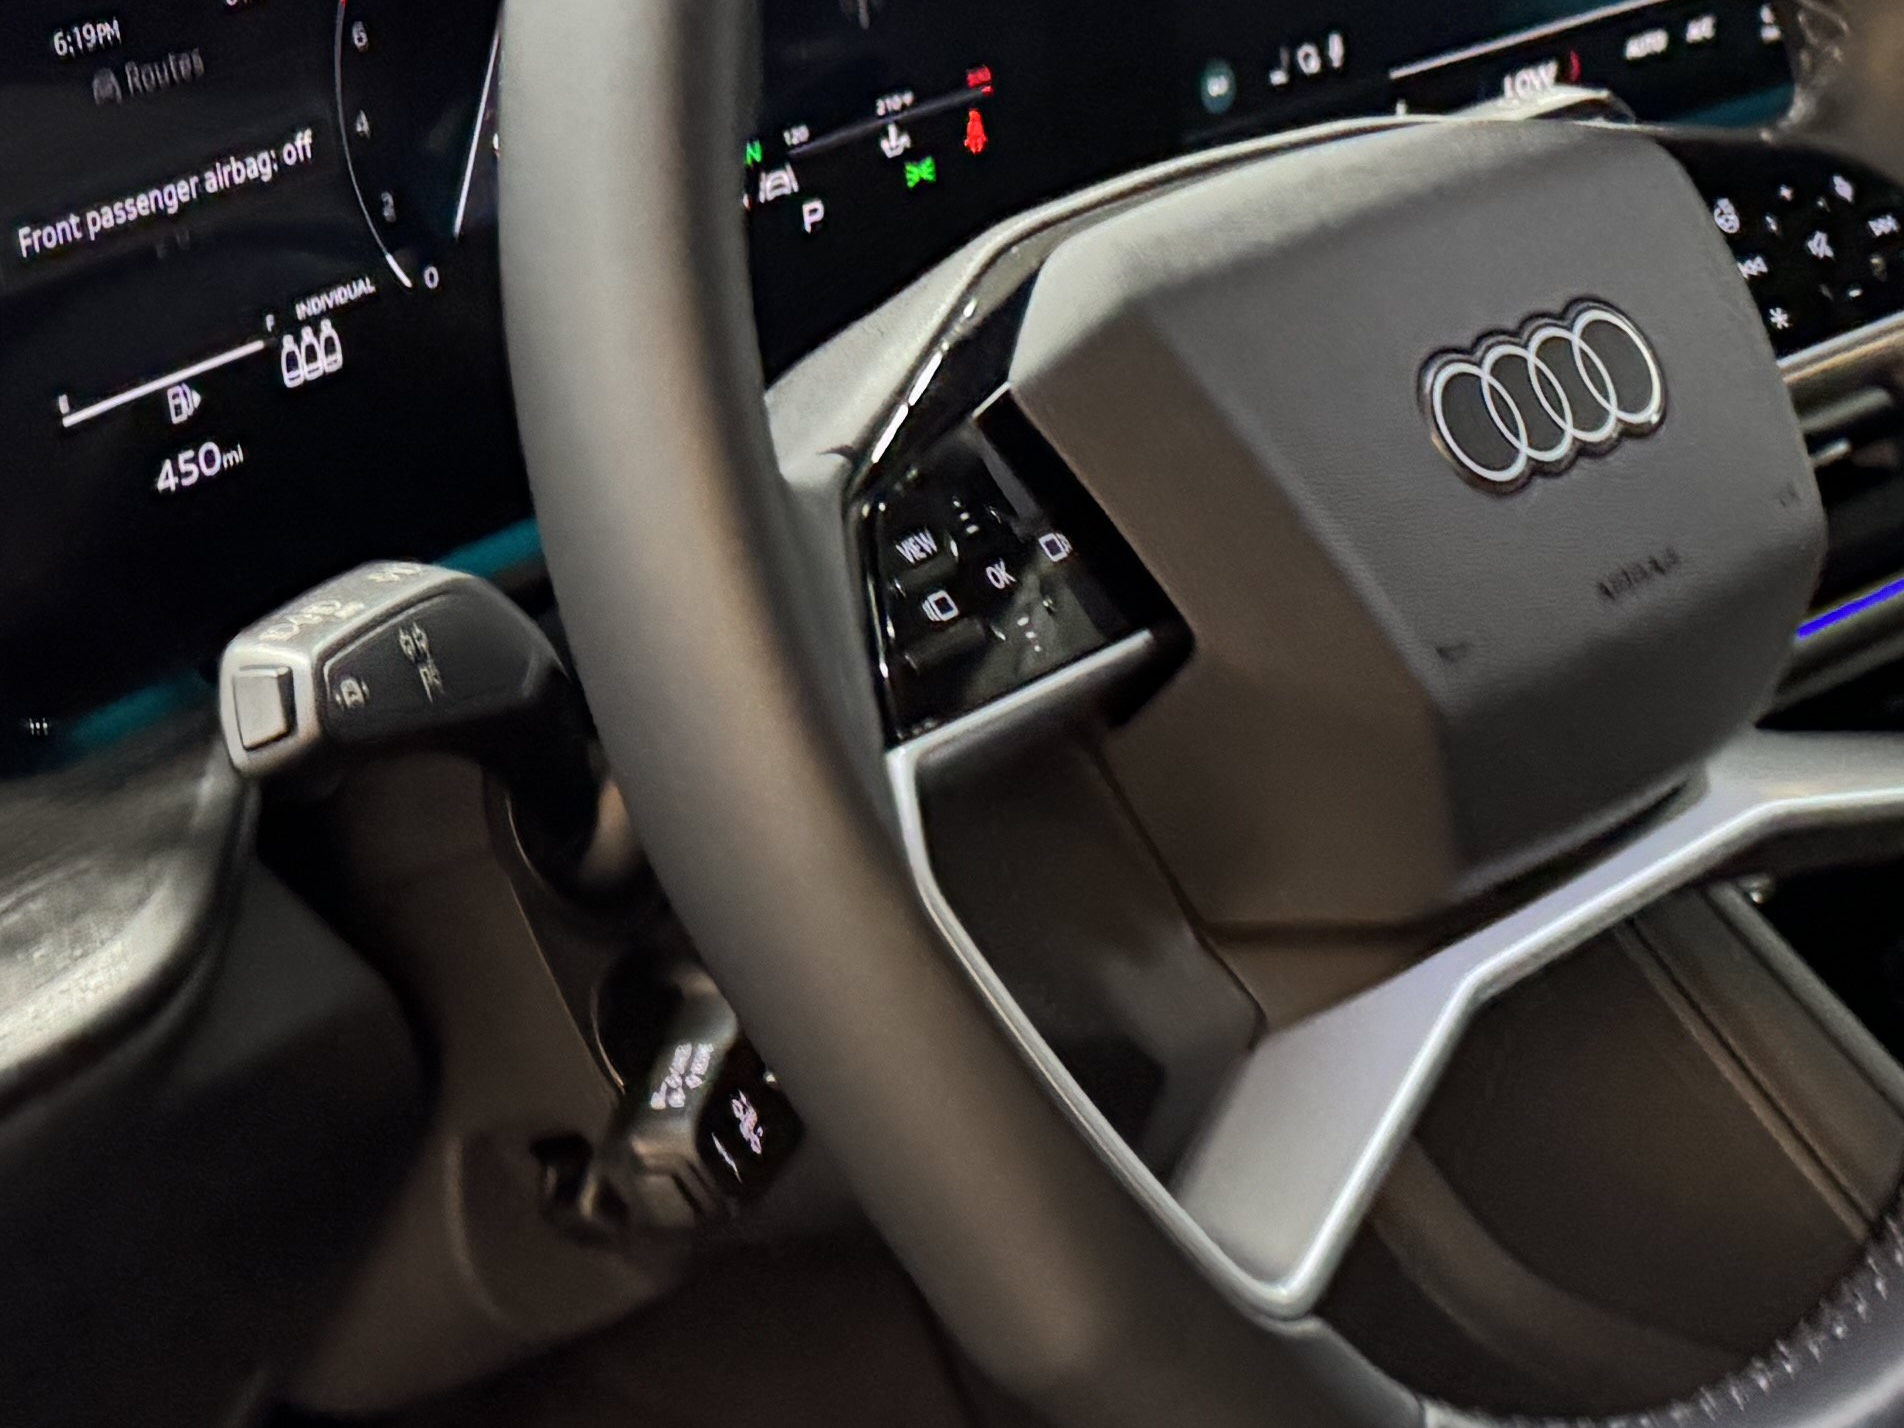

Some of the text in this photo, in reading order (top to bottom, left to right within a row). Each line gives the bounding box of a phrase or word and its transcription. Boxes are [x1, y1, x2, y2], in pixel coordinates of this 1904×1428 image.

[17, 127, 313, 258] Front passenger airbag: off
[802, 198, 825, 233] P
[295, 276, 376, 321] INDIVIDUAL
[895, 528, 938, 564] VIEW
[985, 559, 1017, 589] OK
